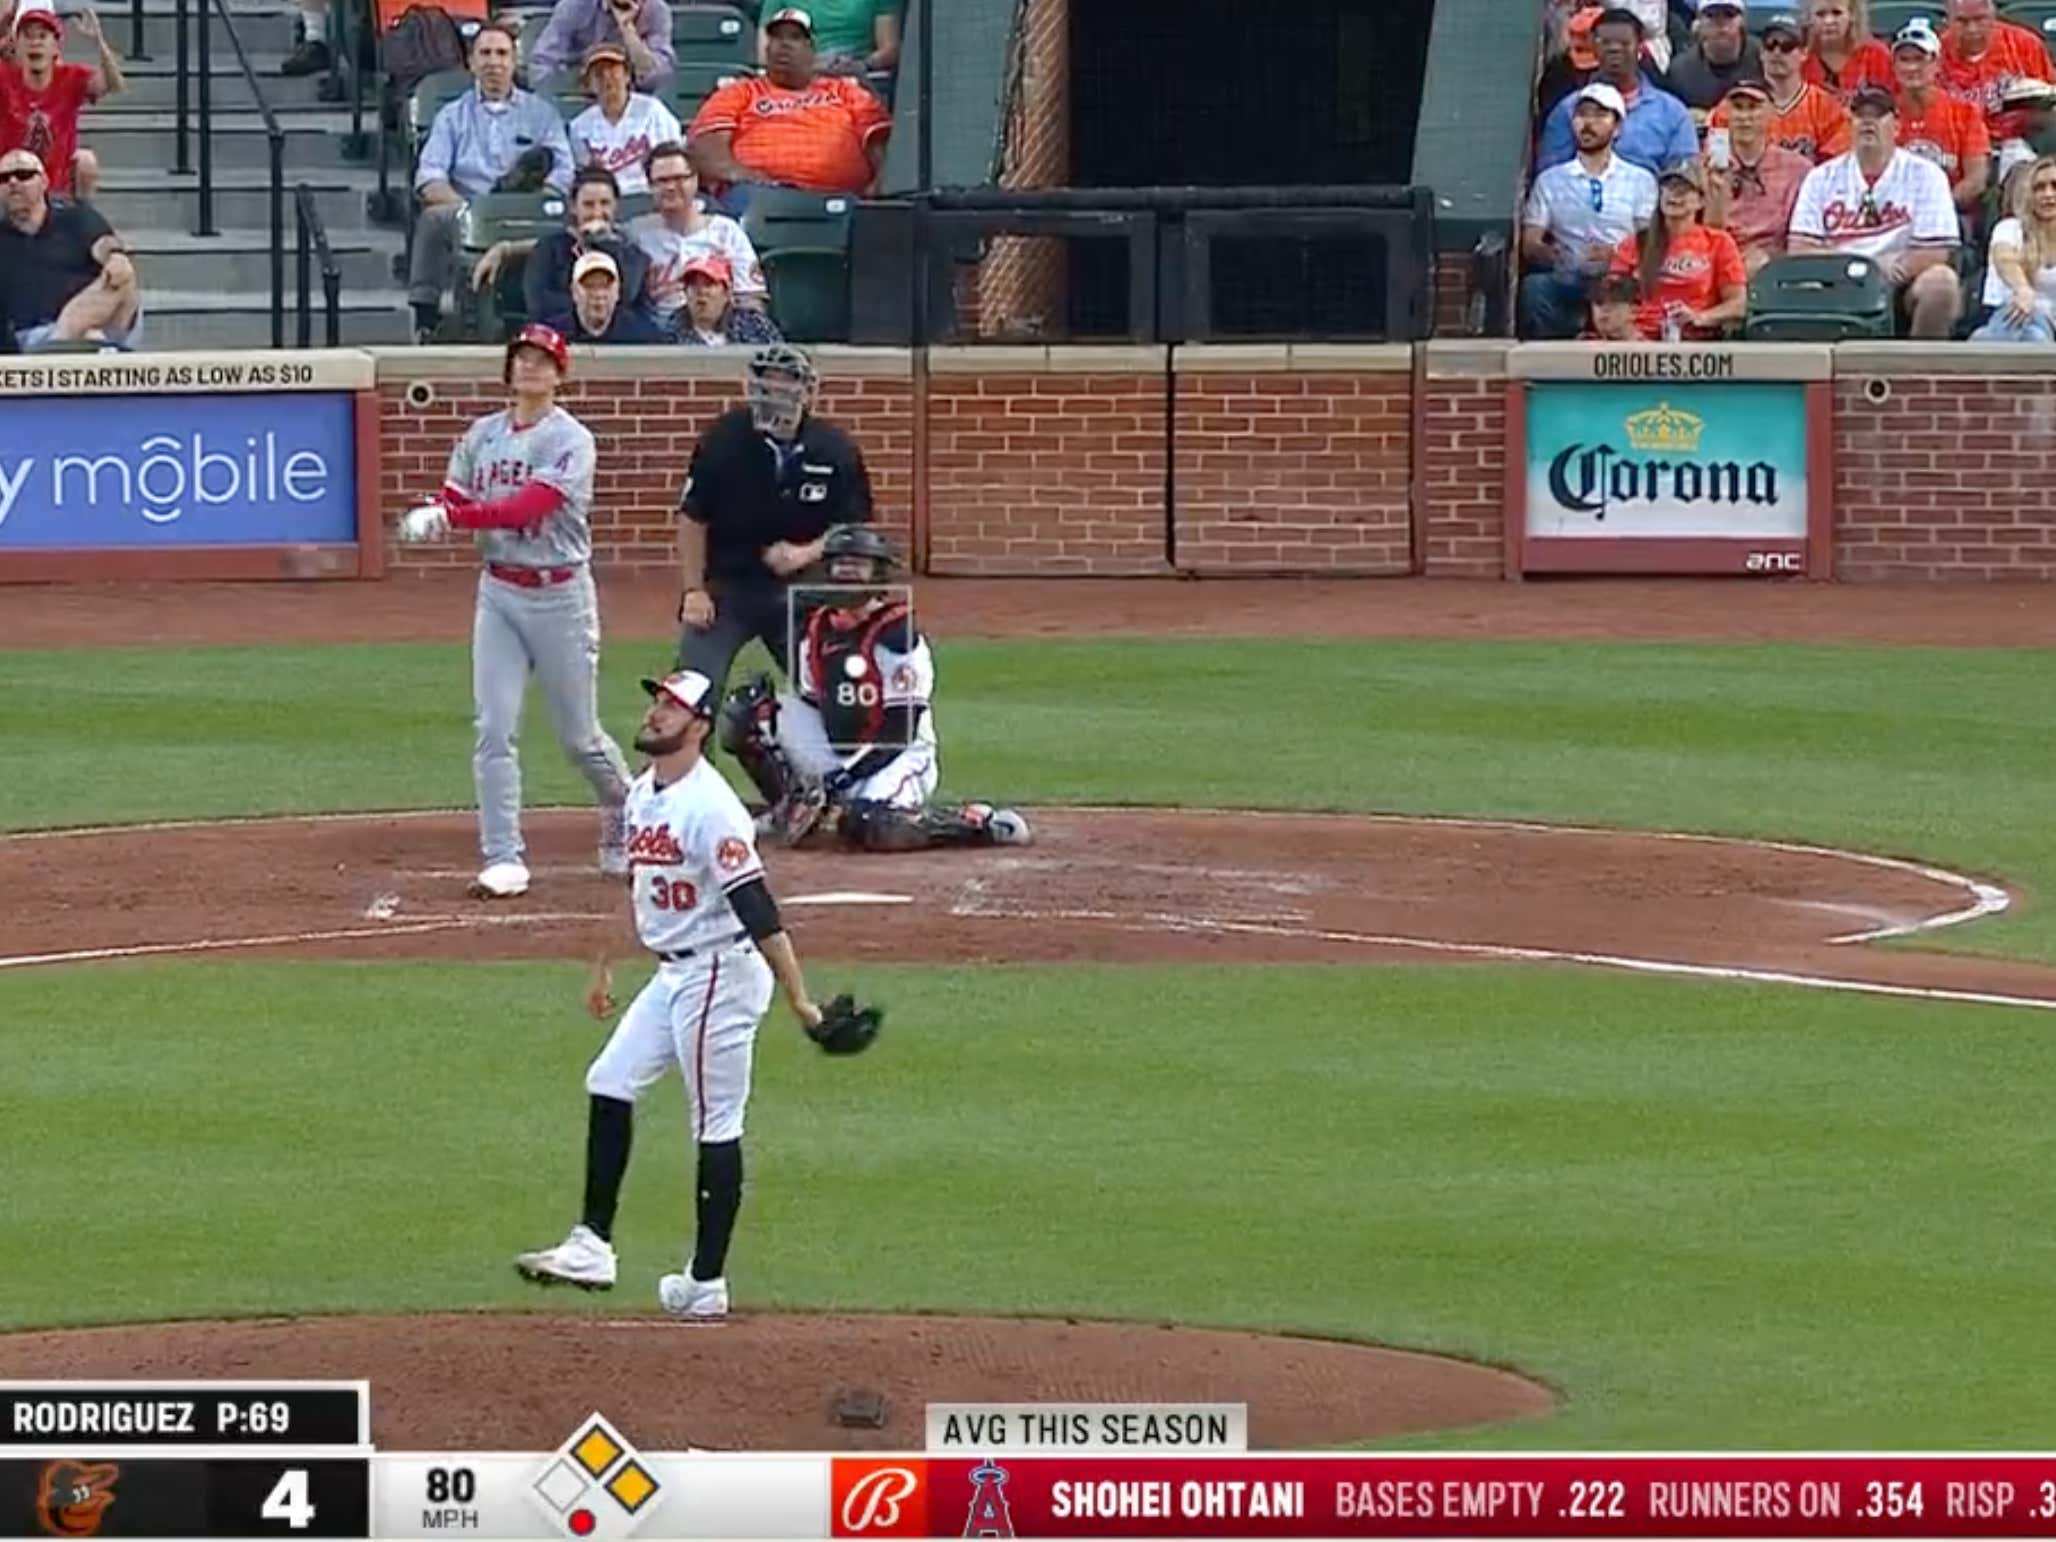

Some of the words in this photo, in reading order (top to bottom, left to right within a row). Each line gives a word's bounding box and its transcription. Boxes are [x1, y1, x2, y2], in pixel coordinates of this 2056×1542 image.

[0, 368, 44, 389] ETS
[58, 366, 161, 388] STARTING
[166, 366, 193, 385] AS
[198, 365, 245, 385] LOW
[248, 364, 276, 384] AS
[280, 363, 313, 384] $10
[1594, 353, 1733, 378] ORIOLES.COM
[1549, 443, 1781, 520] Corona
[1746, 553, 1800, 570] anc
[651, 875, 697, 912] 30
